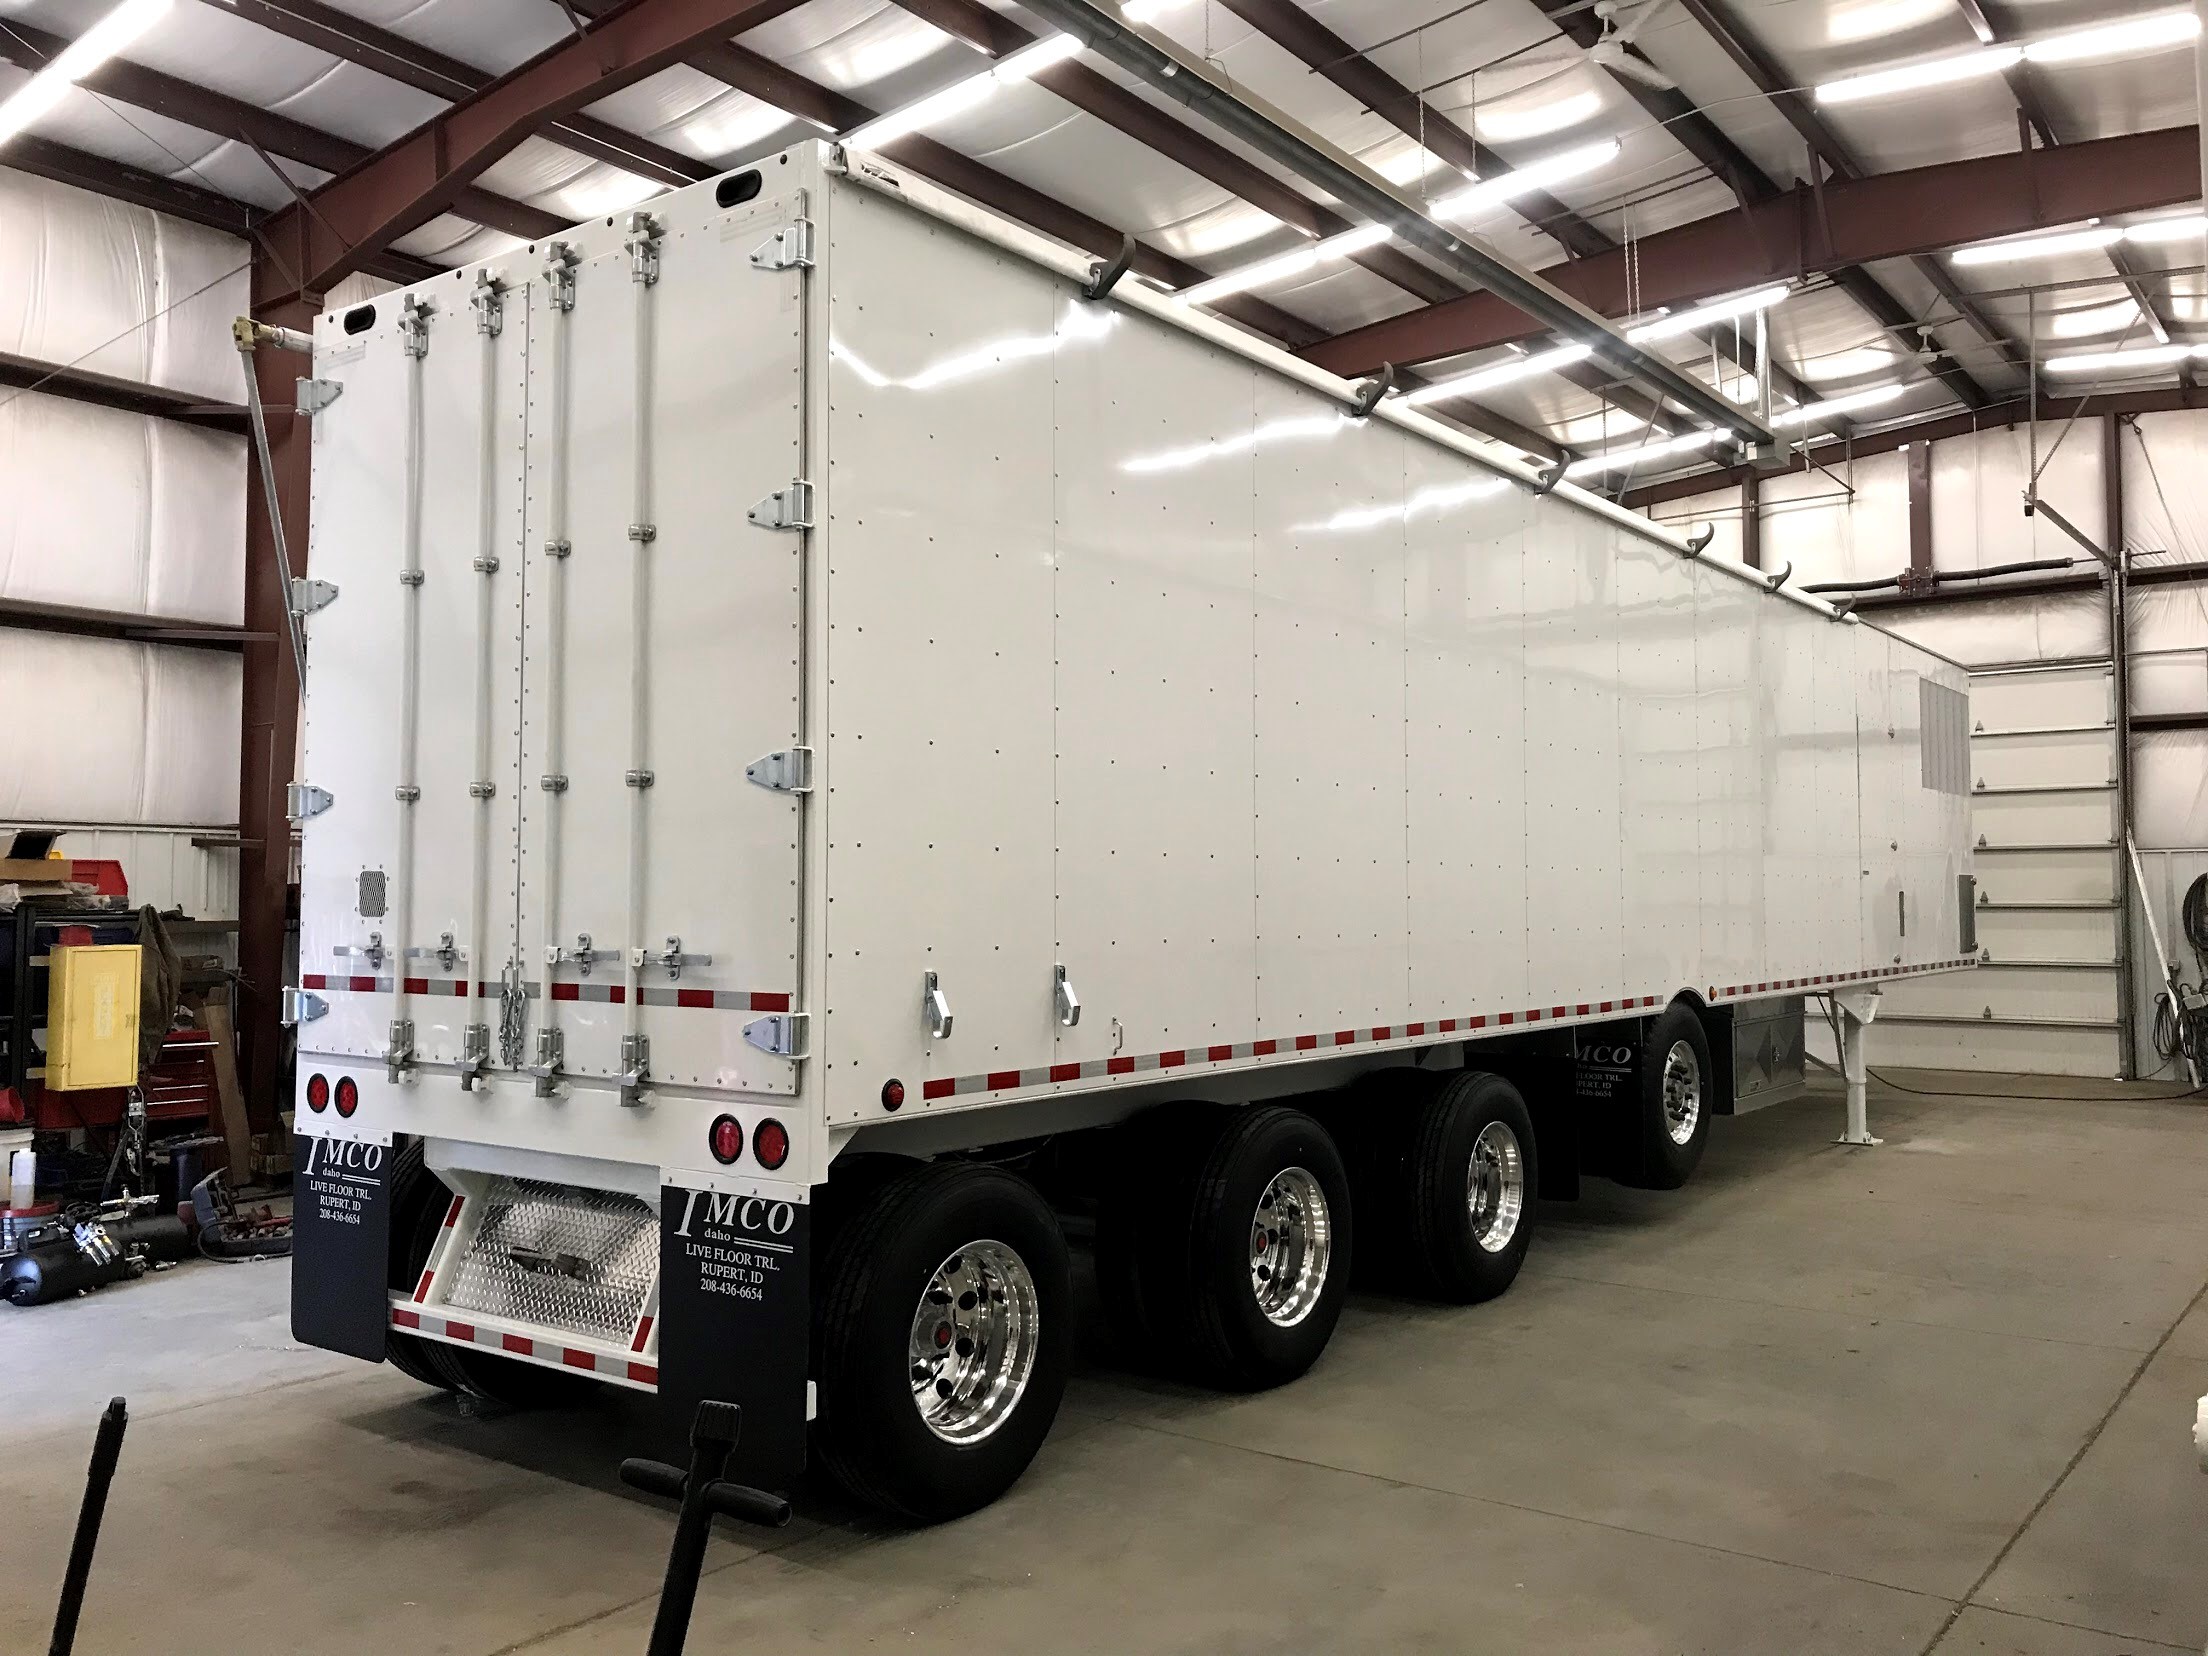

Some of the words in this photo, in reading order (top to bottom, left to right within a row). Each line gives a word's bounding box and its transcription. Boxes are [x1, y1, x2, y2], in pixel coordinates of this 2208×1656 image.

[1576, 1046, 1631, 1064] MCO
[1576, 1080, 1600, 1089] PERT,
[302, 1136, 383, 1175] IMCO
[322, 1167, 341, 1178] daho
[310, 1180, 328, 1192] LIVE
[328, 1183, 354, 1197] FLOOR
[355, 1187, 372, 1200] TRL.
[320, 1195, 351, 1211] RUPERT,
[352, 1200, 361, 1211] ID
[673, 1188, 795, 1237] IMCO
[319, 1208, 360, 1225] 208-436-6654
[704, 1228, 731, 1241] daho
[685, 1242, 712, 1259] LIVE
[714, 1248, 752, 1266] FLOOR
[754, 1255, 780, 1271] TRL.
[701, 1262, 748, 1283] RUPERT,
[750, 1271, 764, 1284] ID
[700, 1278, 763, 1301] 208-436-6654
